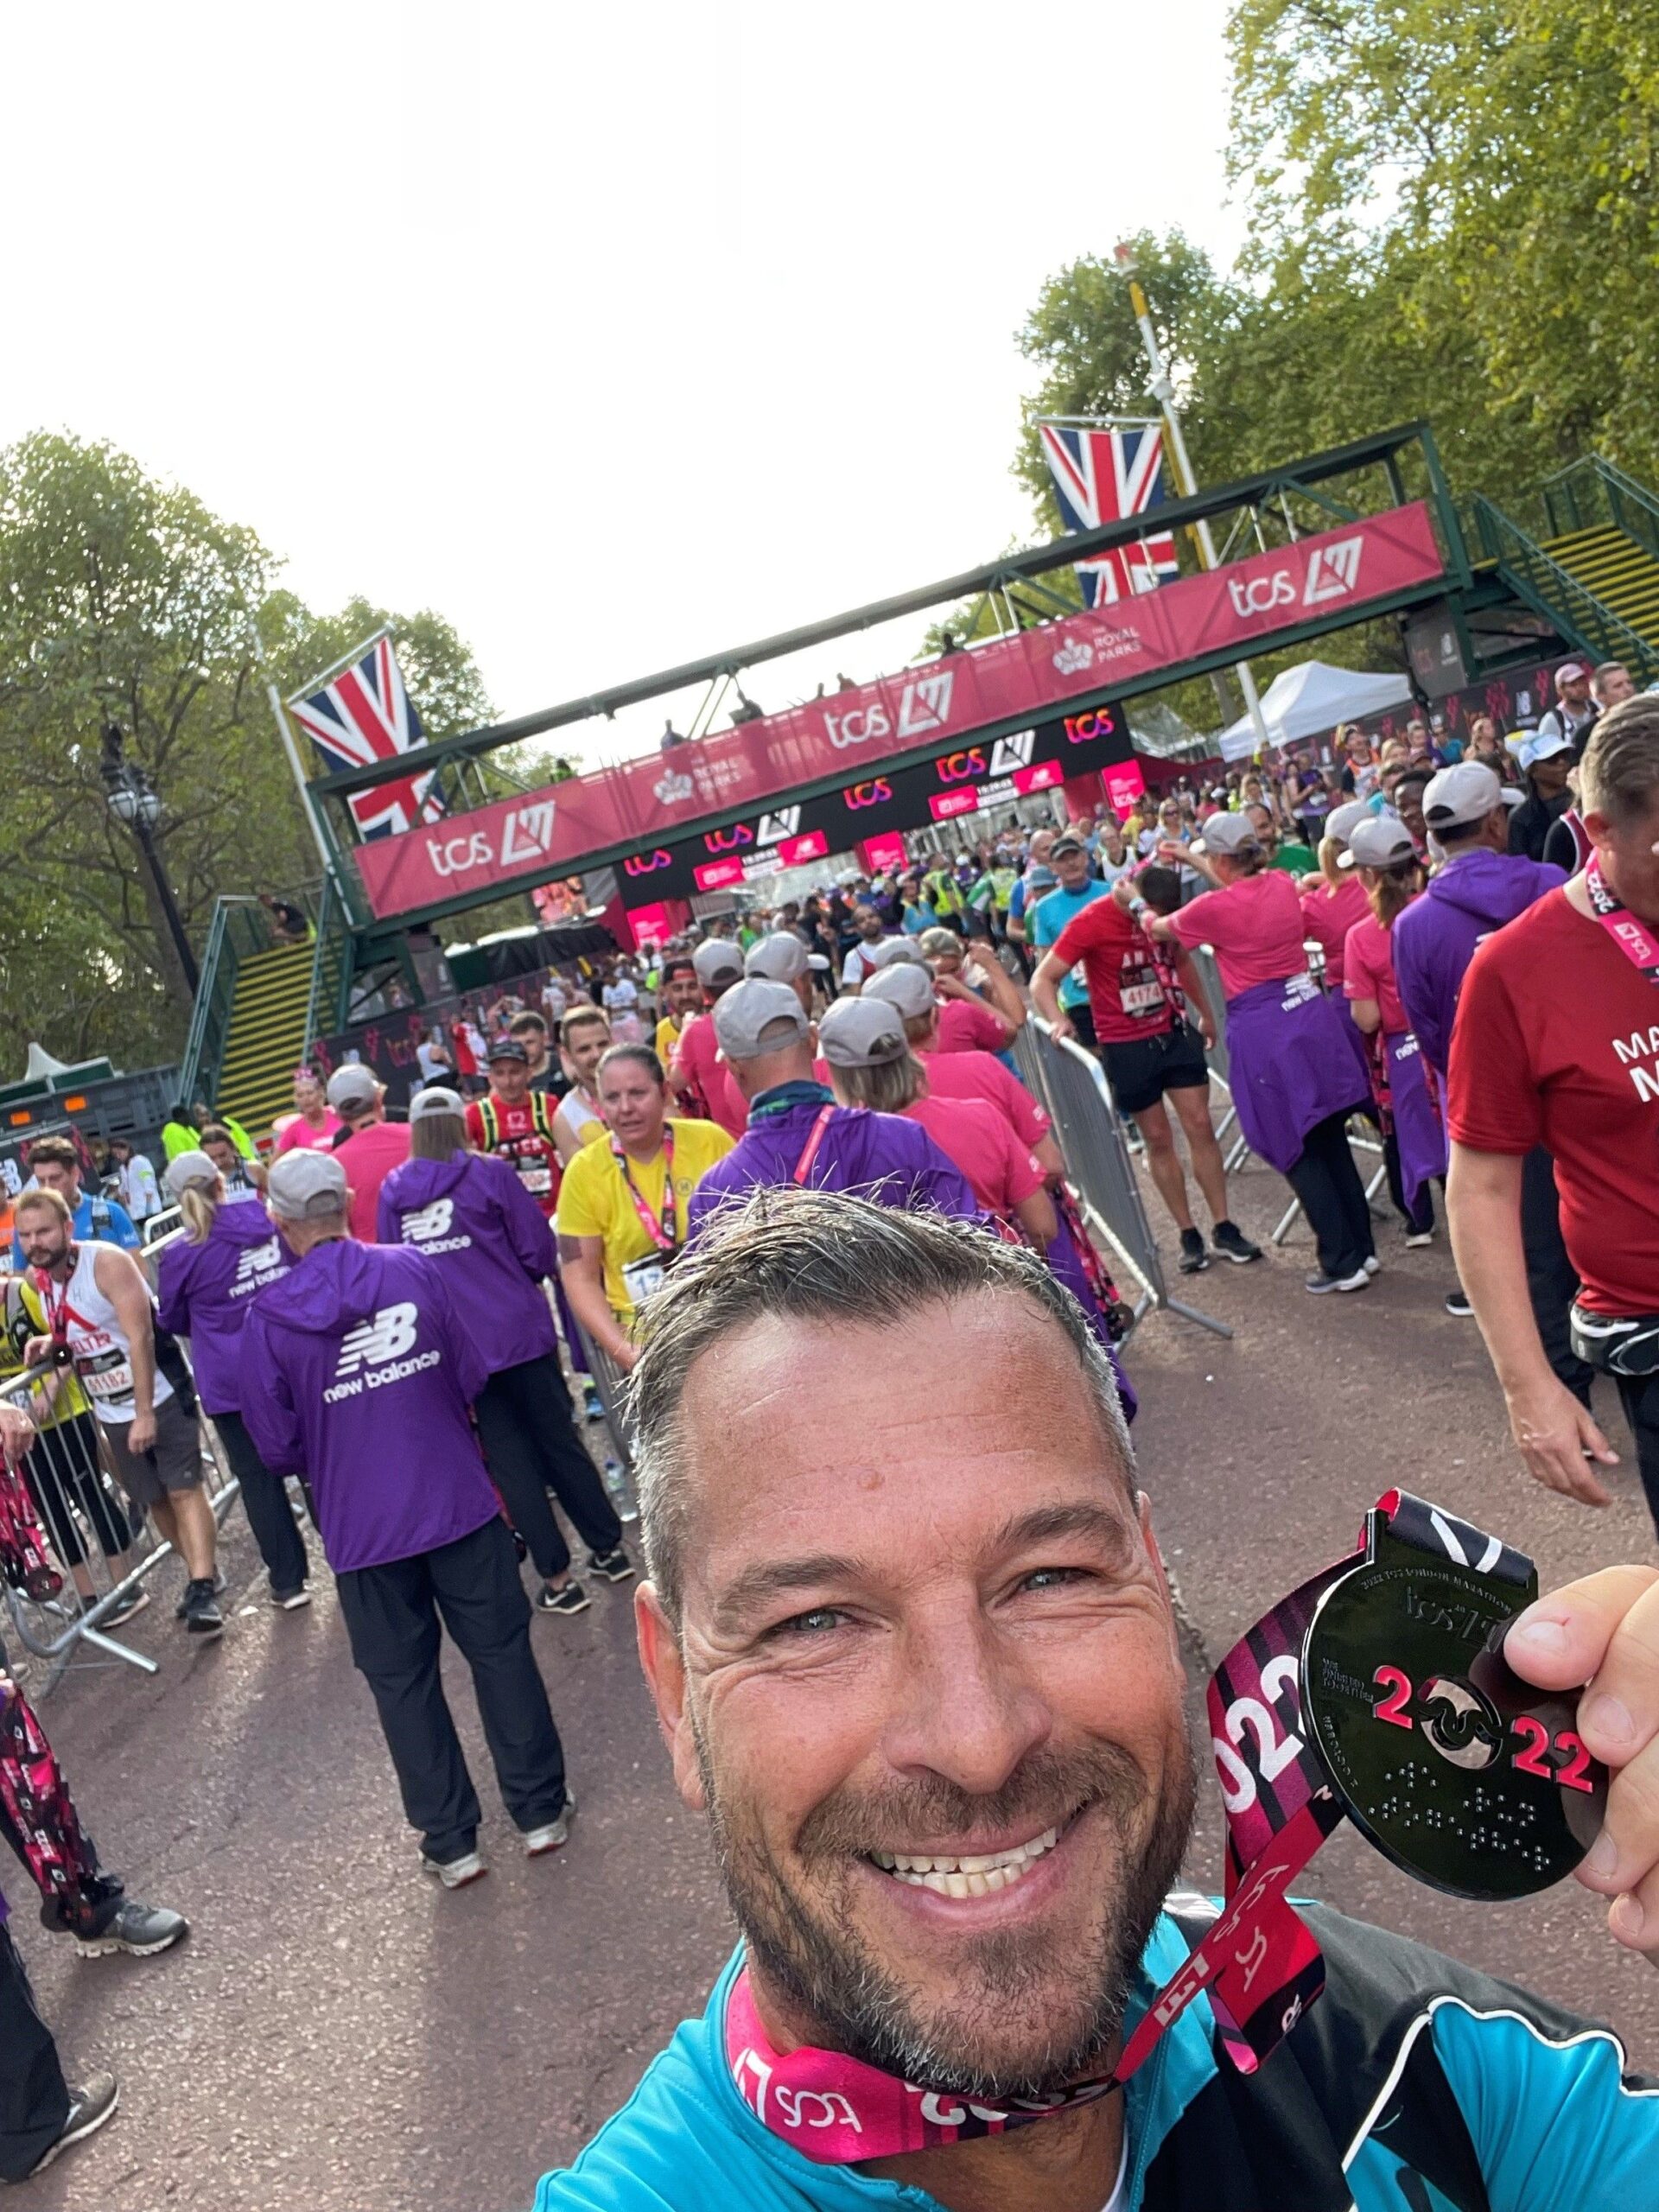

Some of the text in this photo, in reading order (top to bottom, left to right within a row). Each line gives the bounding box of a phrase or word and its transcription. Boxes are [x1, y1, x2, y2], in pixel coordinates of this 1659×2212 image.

[1228, 569, 1295, 618] tcs
[1094, 626, 1141, 648] ROYAL
[1098, 640, 1142, 663] PARKS
[823, 704, 890, 749] tcs
[426, 831, 493, 876] tcs
[422, 1235, 472, 1255] alance
[322, 1350, 441, 1404] new balance
[775, 2085, 863, 2133] tcs
